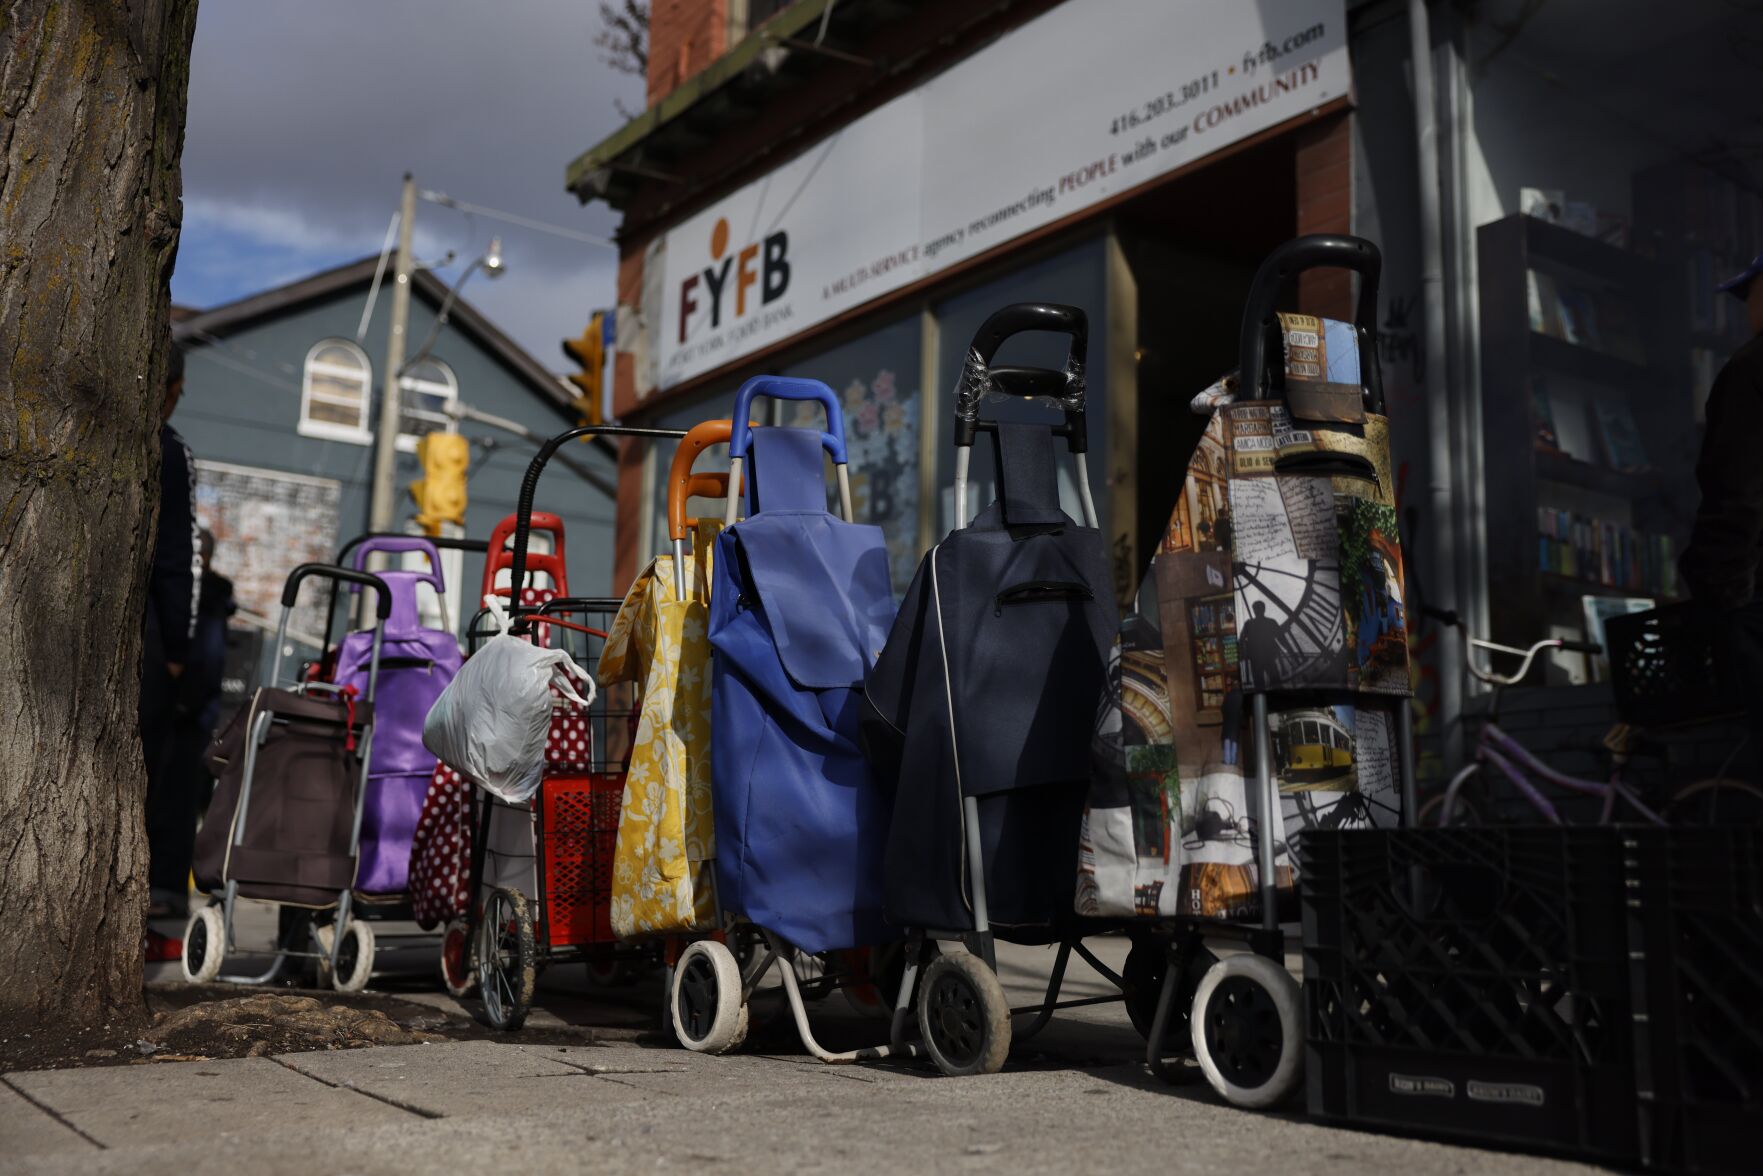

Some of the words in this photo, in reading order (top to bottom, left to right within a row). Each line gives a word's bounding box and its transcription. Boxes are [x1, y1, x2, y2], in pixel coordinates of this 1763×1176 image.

[1110, 70, 1219, 135] 416.203.3011
[1243, 21, 1325, 76] fyfb.com
[923, 228, 965, 259] agency
[968, 186, 1056, 235] reconnecting
[1058, 152, 1118, 194] PEOPLE
[1122, 136, 1157, 166] with
[1160, 125, 1189, 149] our
[1193, 58, 1321, 134] COMMUNITY
[679, 230, 791, 344] FYFB
